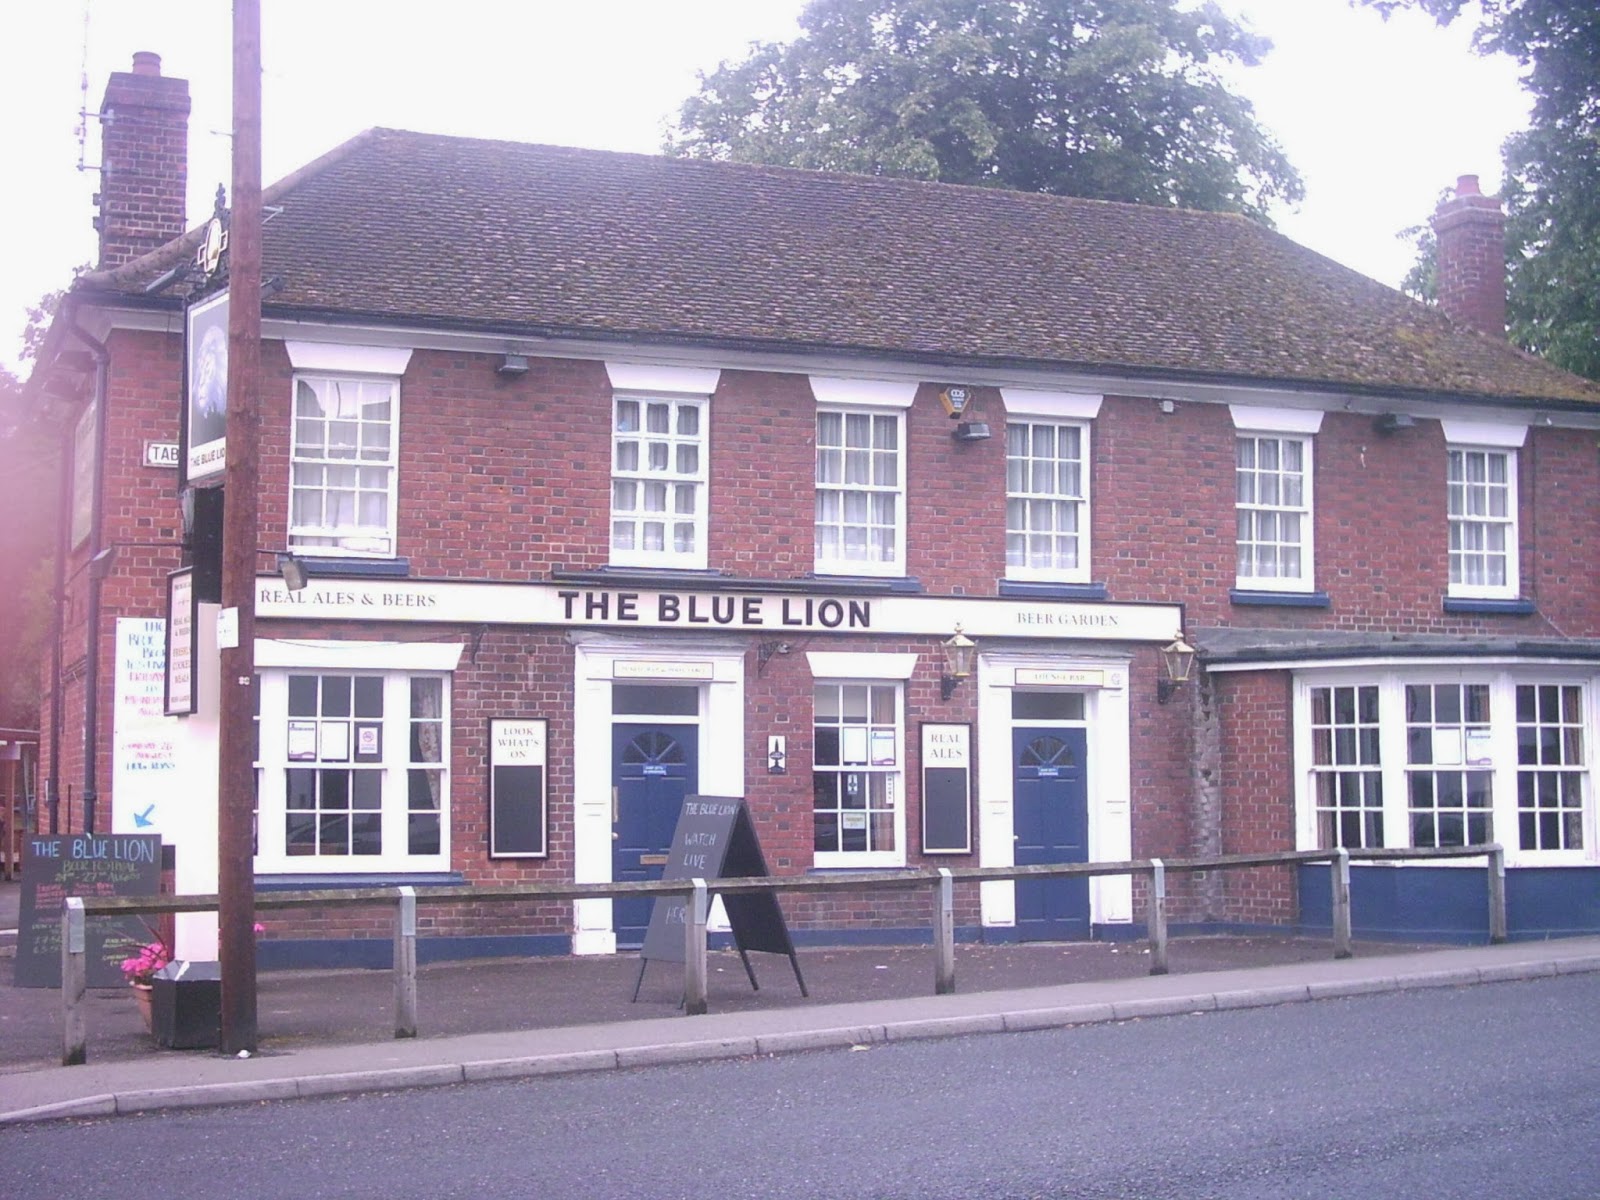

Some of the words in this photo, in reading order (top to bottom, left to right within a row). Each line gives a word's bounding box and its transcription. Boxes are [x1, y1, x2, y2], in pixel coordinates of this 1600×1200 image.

[152, 446, 179, 461] TAB
[261, 589, 306, 604] REAL
[312, 591, 355, 605] ALES
[361, 593, 374, 605] &
[383, 593, 436, 607] BEERS
[558, 590, 639, 621] THE
[658, 594, 764, 625] BLUE
[782, 598, 871, 628] LION
[1017, 612, 1055, 625] BEER
[1058, 614, 1119, 626] GARDEN
[503, 727, 533, 736] LOOK
[931, 734, 960, 743] REAL
[498, 738, 539, 748] WHAT'S
[510, 750, 526, 758] ON
[930, 748, 962, 759] ALES
[686, 802, 699, 816] THE
[700, 802, 718, 815] BLUE
[685, 832, 716, 846] WATCH
[32, 841, 60, 858] THE
[73, 839, 108, 859] BLUE
[115, 839, 154, 863] LION
[683, 854, 707, 870] LIVE
